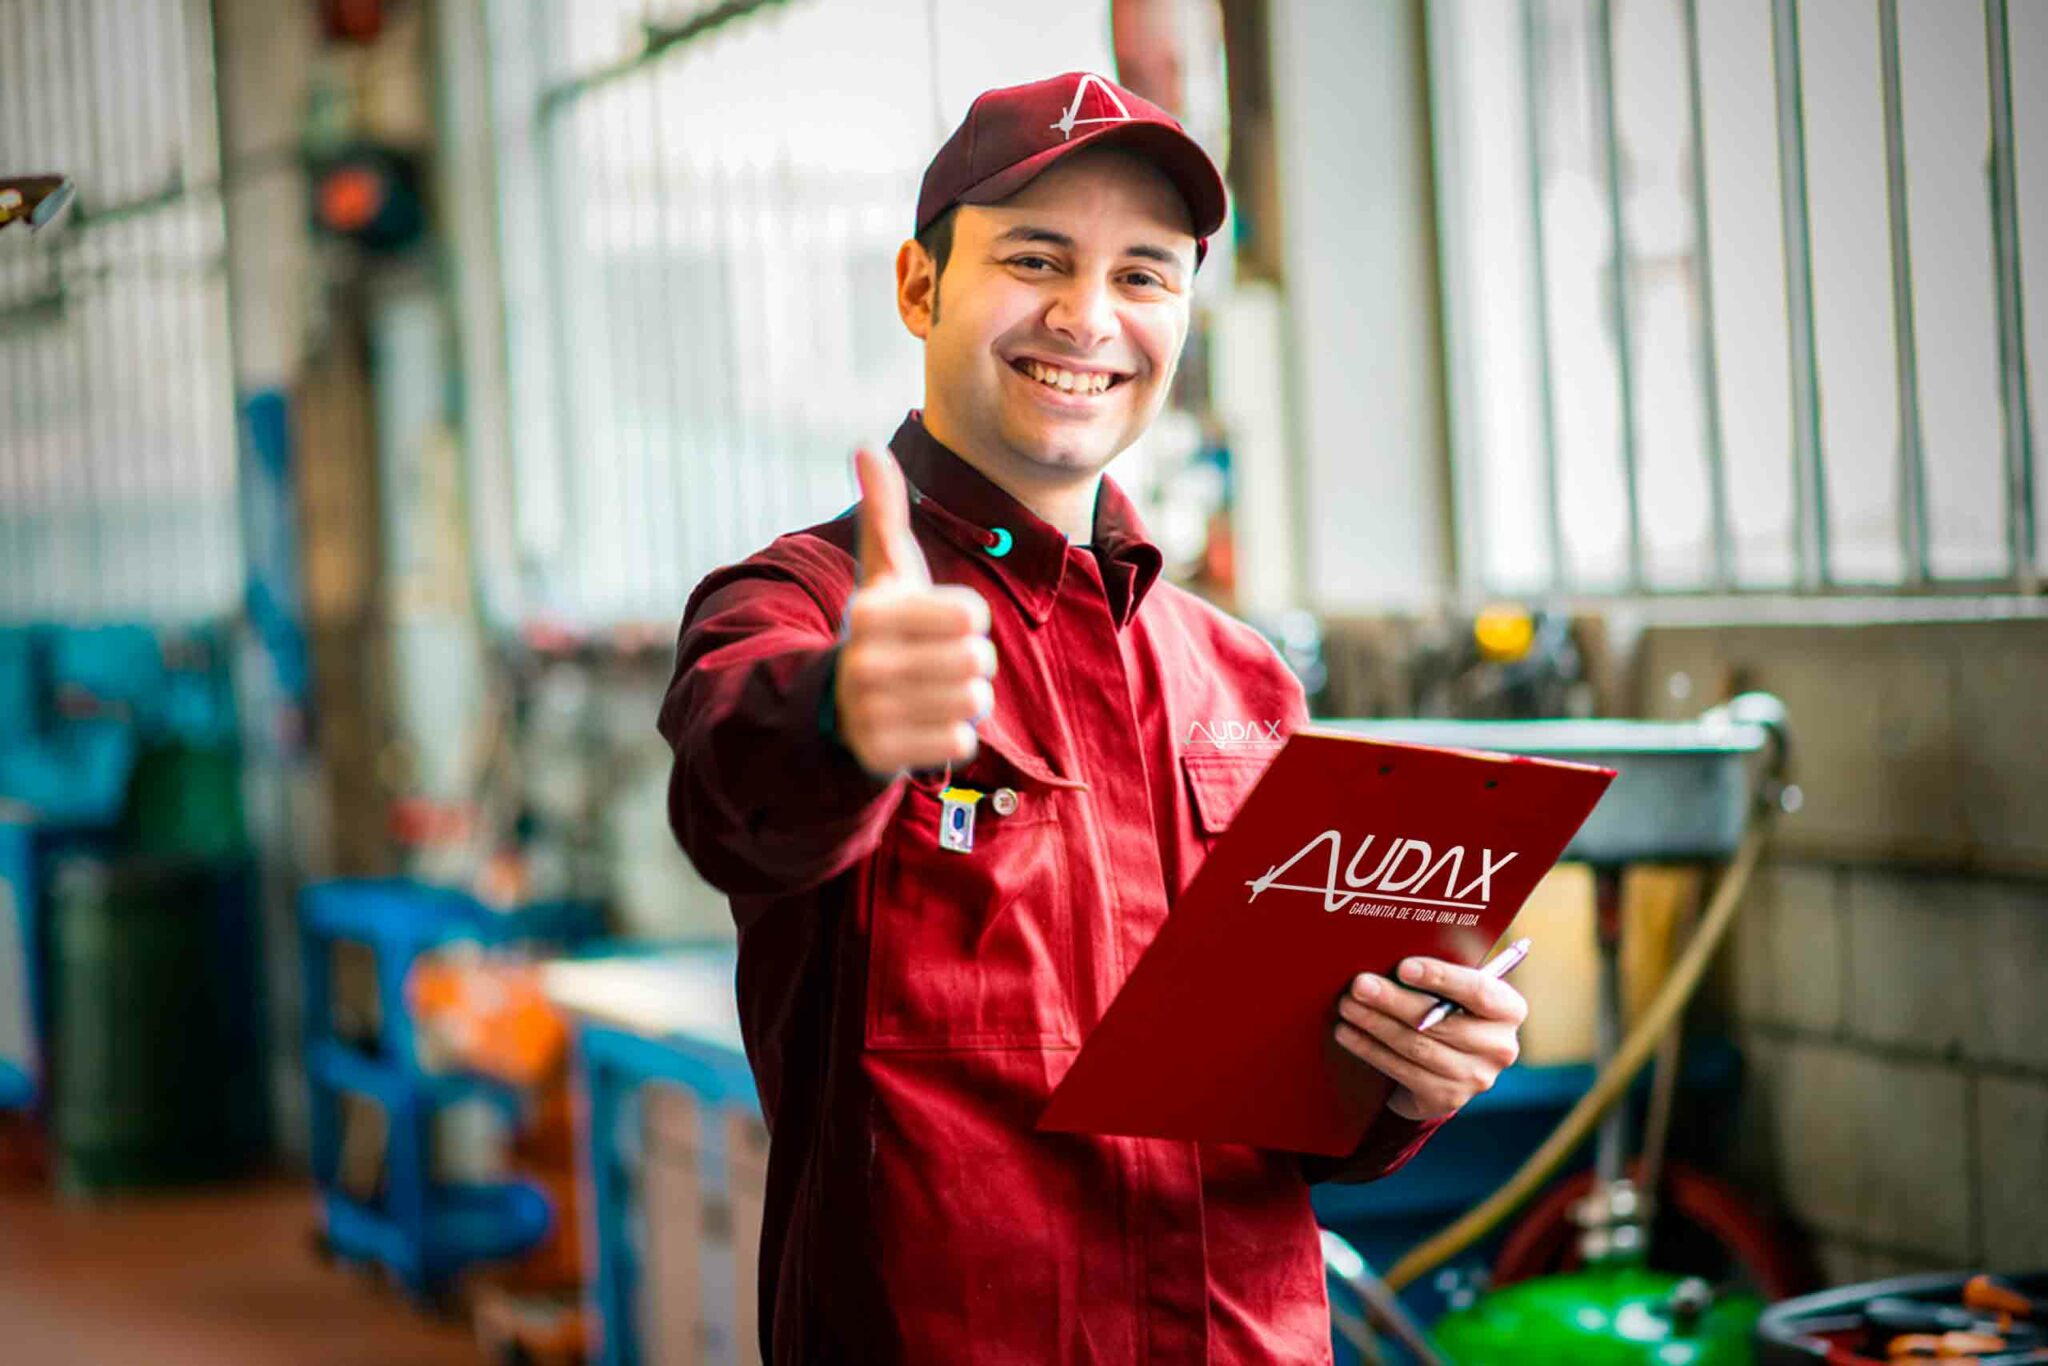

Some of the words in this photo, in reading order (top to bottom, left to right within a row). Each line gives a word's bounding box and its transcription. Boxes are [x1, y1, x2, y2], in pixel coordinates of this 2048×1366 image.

[1184, 719, 1281, 749] AUDAX
[1245, 830, 1519, 912] AUDAX
[1349, 902, 1394, 917] GARANTÍA
[1396, 908, 1410, 919] DE
[1411, 909, 1435, 921] TODA
[1436, 911, 1456, 923] UNA
[1457, 914, 1479, 926] VIDA
